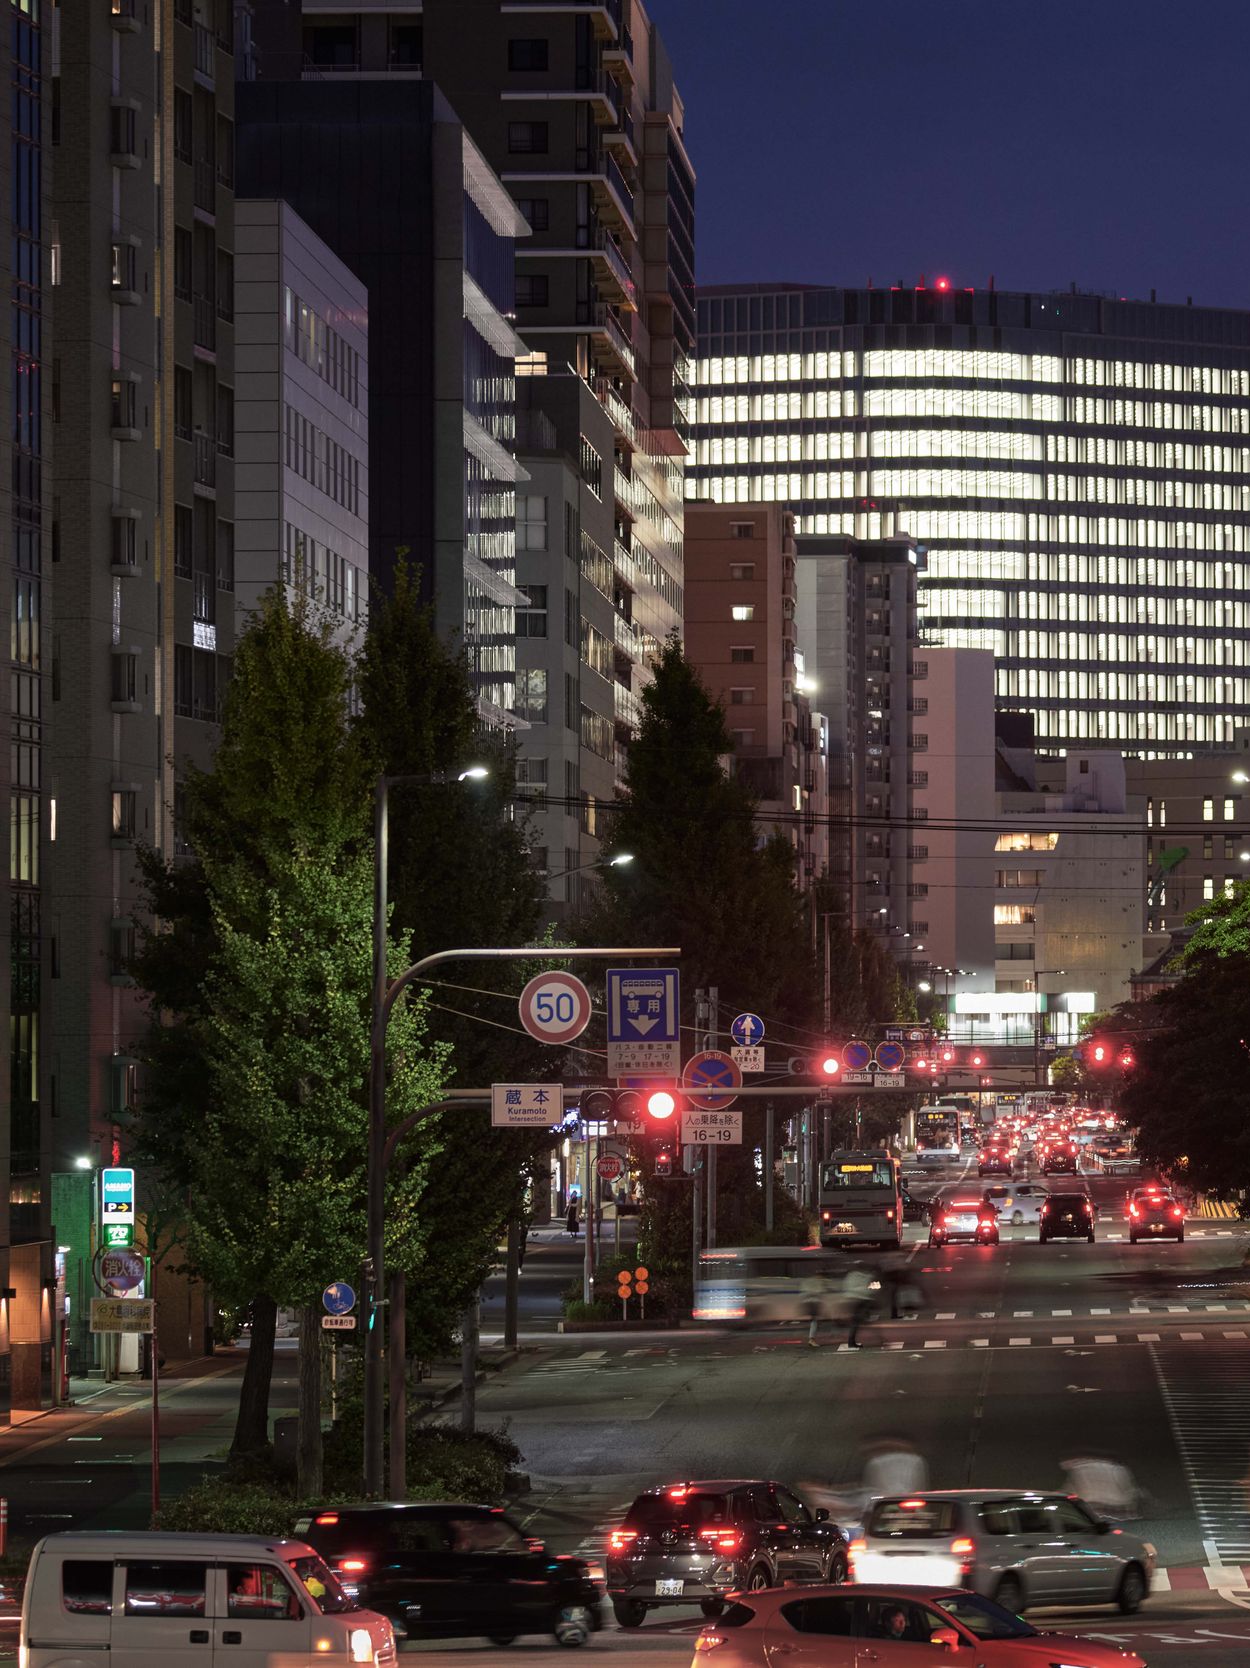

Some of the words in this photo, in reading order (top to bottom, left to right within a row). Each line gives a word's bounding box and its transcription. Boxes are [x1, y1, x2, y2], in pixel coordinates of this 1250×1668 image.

[536, 992, 574, 1023] 50
[626, 999, 661, 1013] 専用
[505, 1089, 550, 1105] 蔵本
[507, 1108, 547, 1116] Kuramoto
[685, 1114, 740, 1125] 人の乗降を除く
[692, 1129, 732, 1141] 16-19
[108, 1203, 117, 1212] P
[105, 1259, 142, 1277] 消火栓
